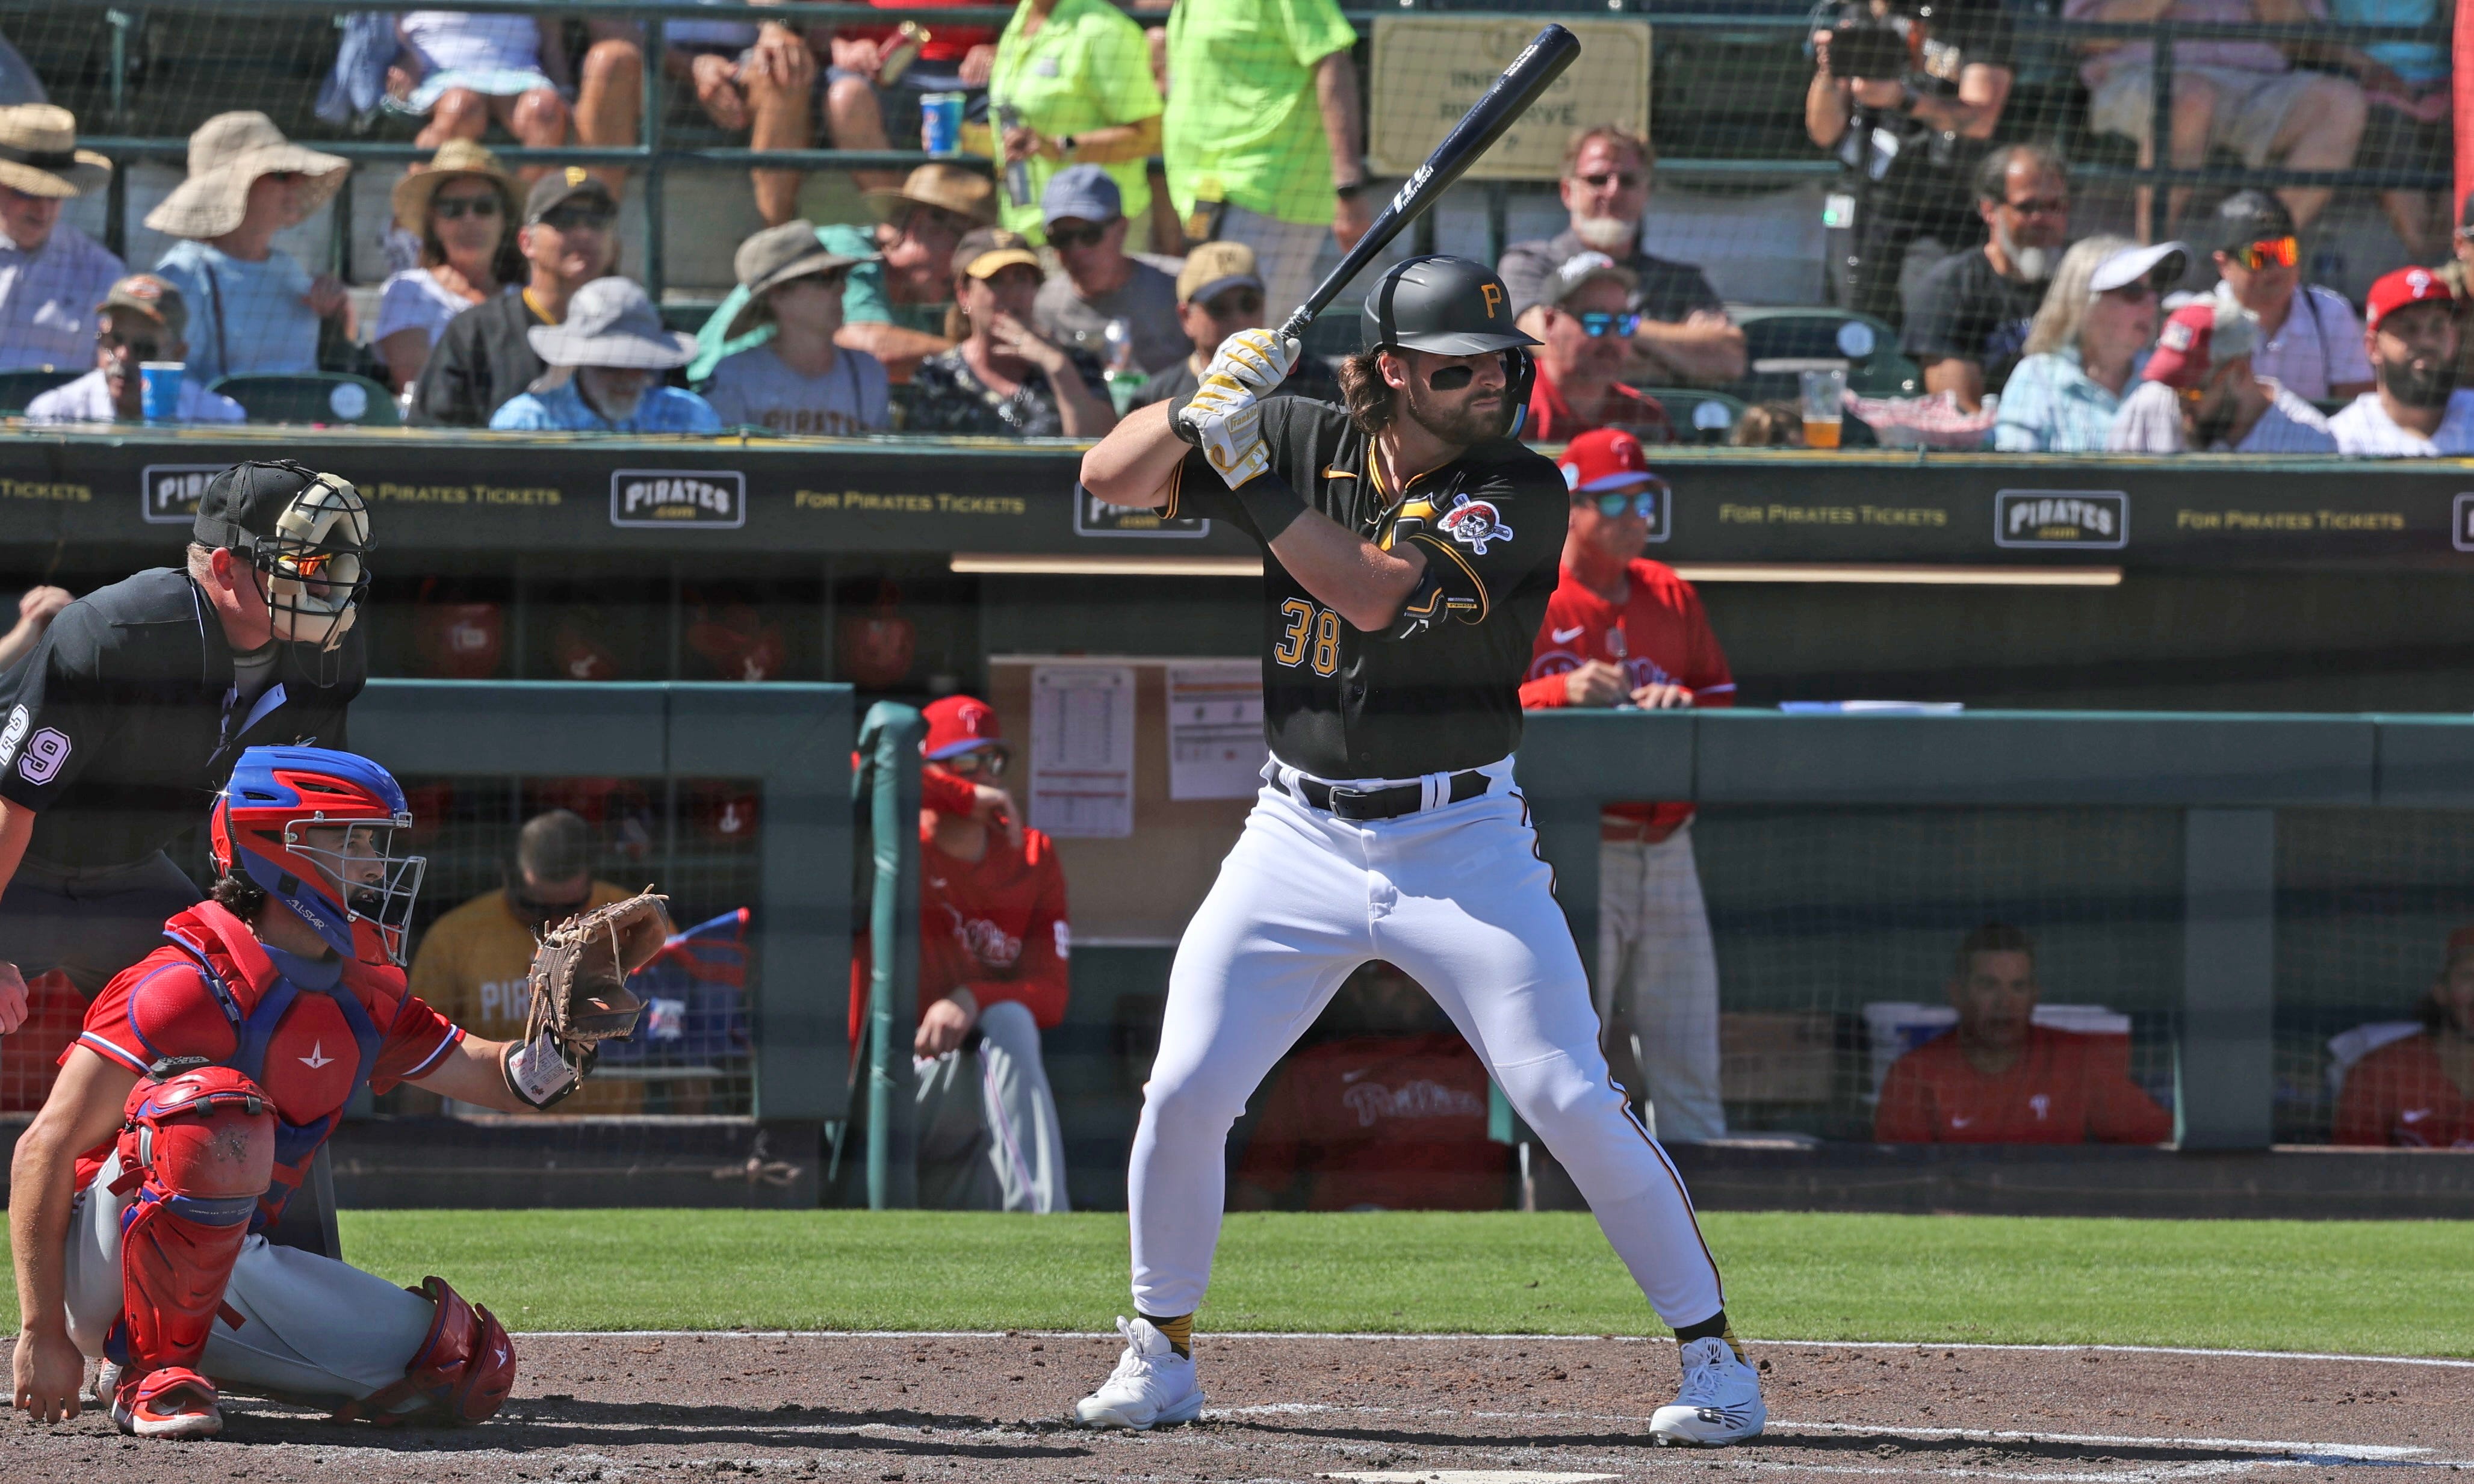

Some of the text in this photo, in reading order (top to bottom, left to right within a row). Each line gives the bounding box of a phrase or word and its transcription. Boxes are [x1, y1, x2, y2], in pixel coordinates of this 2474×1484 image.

[1481, 283, 1502, 318] P
[1230, 407, 1257, 431] Franklin
[625, 478, 731, 514] PIRATES
[2009, 498, 2113, 535] PIRATES
[1274, 596, 1341, 678] 38
[0, 703, 72, 786] 29
[286, 899, 325, 930] ALL-STAR
